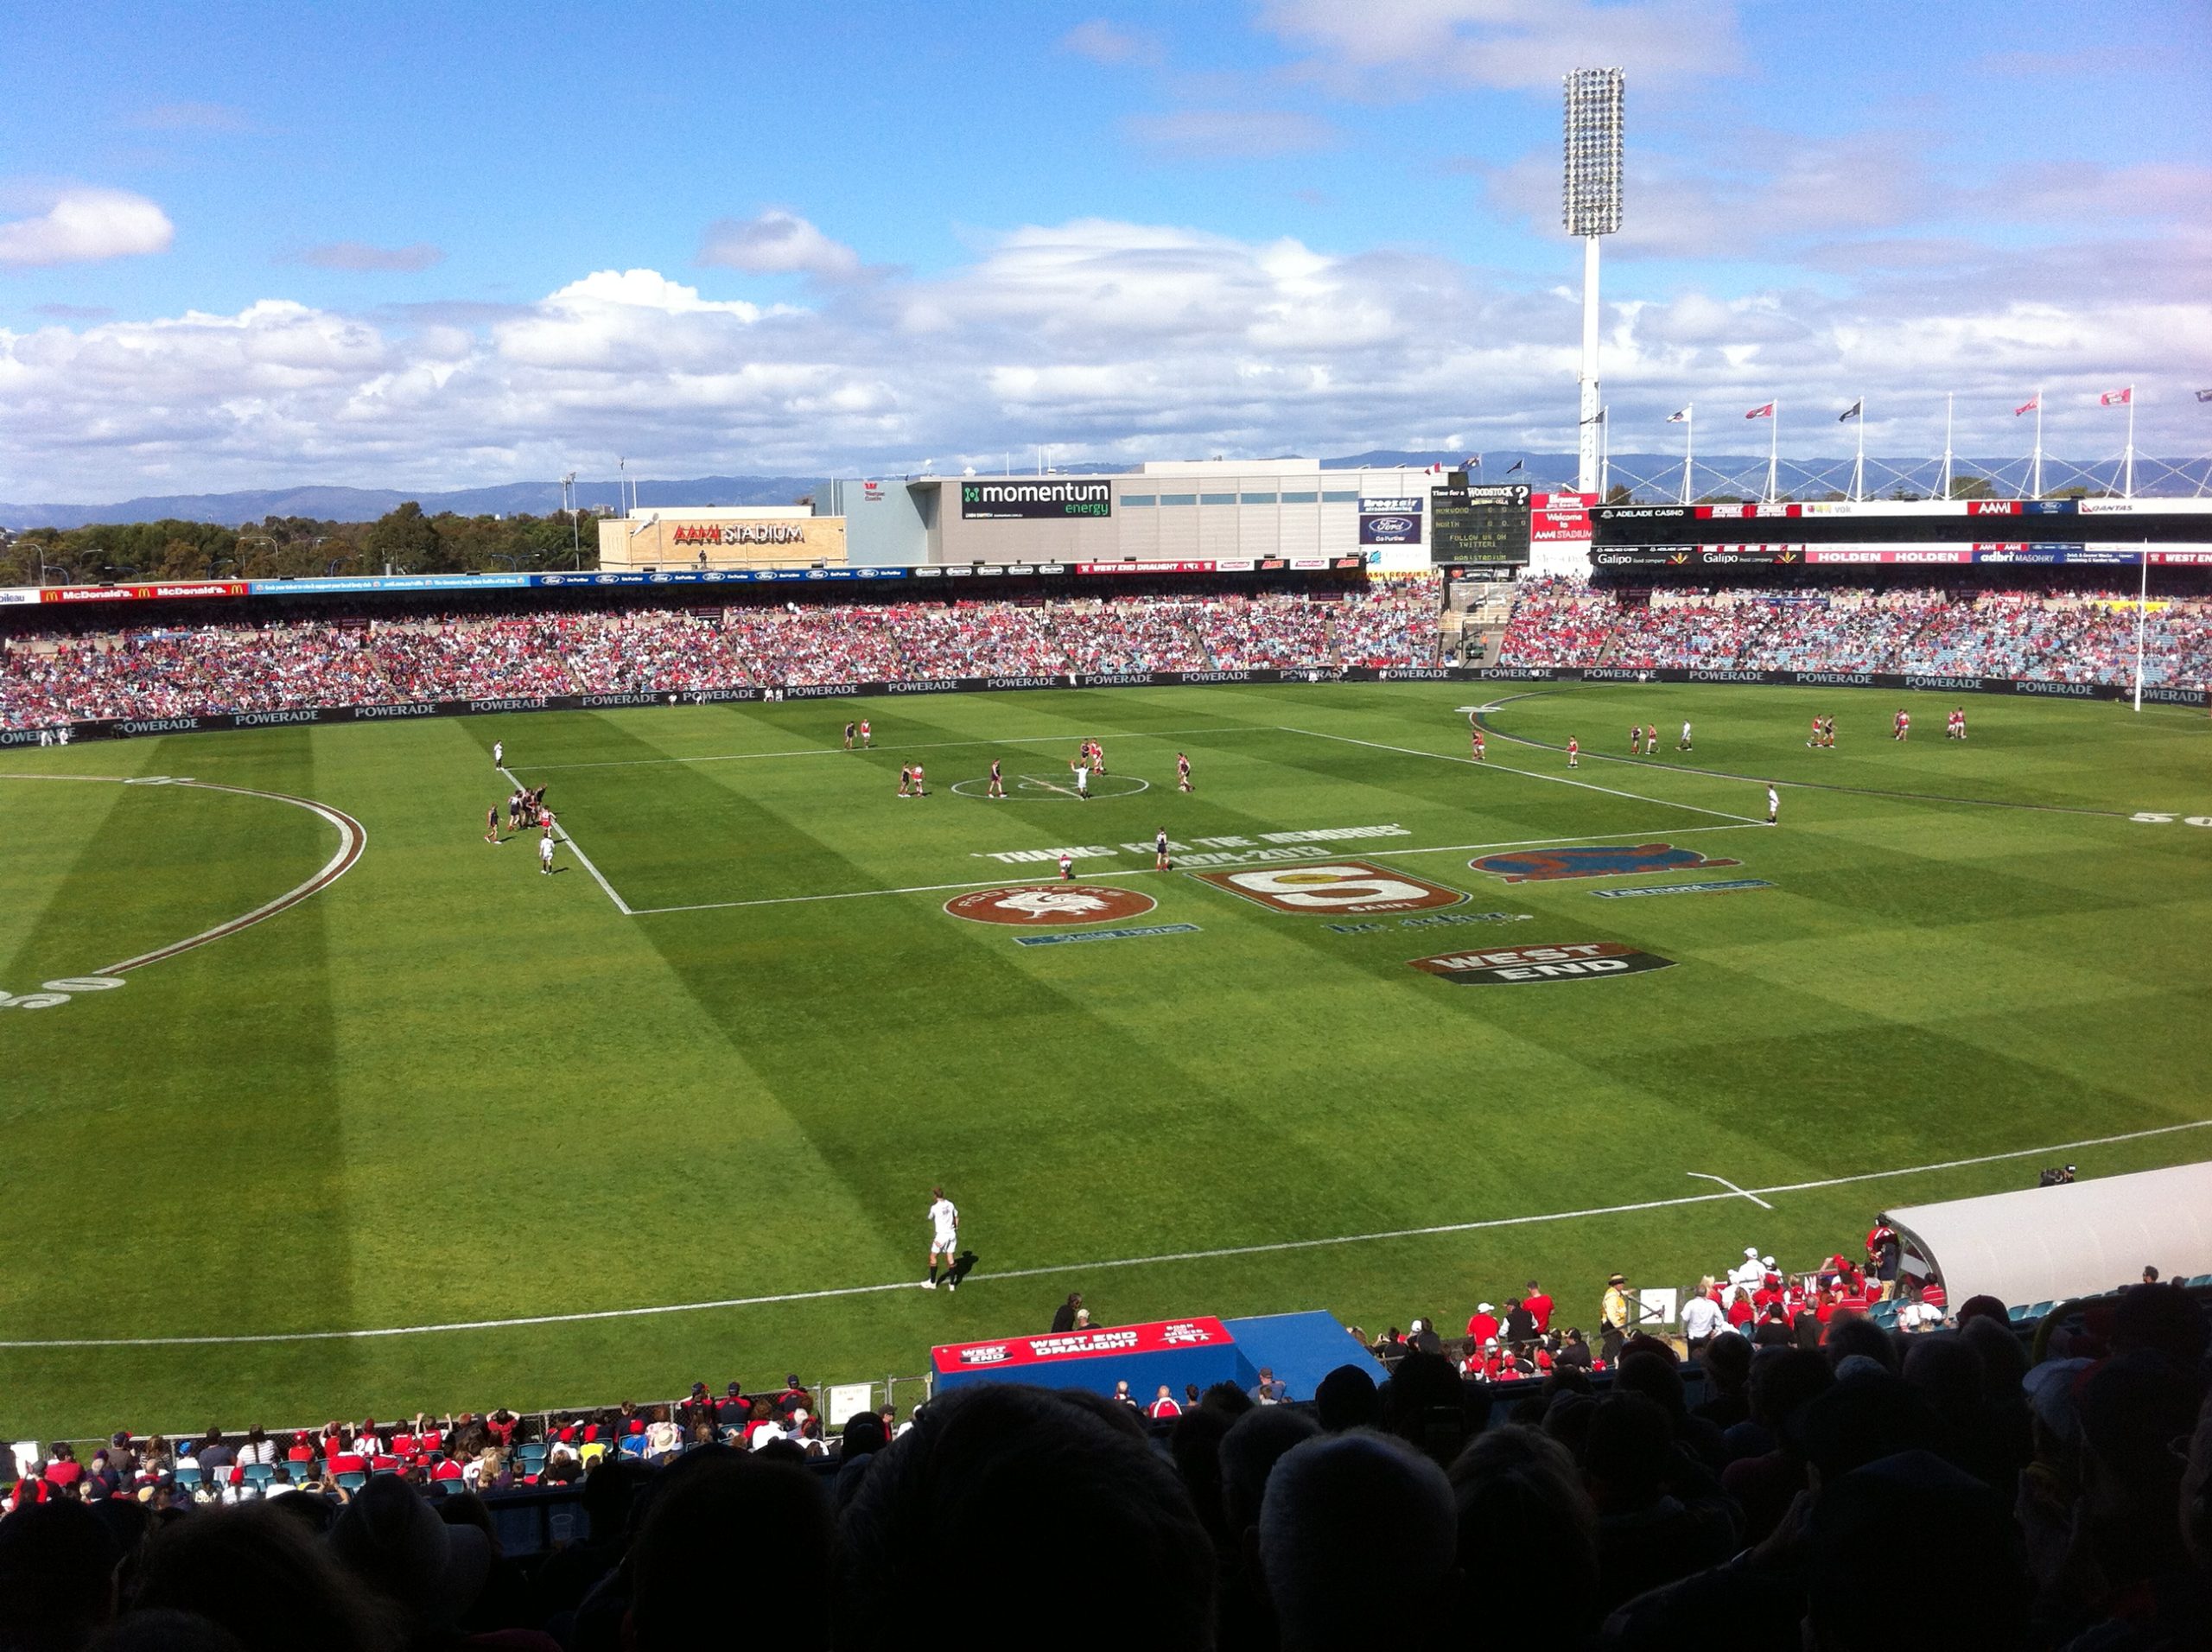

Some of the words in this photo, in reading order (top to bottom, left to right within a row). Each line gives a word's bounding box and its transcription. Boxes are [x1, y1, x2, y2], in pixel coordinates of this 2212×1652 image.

[982, 482, 1109, 502] momentum
[1467, 486, 1514, 498] WOODSTOCK
[1065, 503, 1109, 516] energy
[1978, 502, 2011, 514] AAMI
[1547, 512, 1582, 521] Welcome
[1376, 519, 1406, 531] Ford
[673, 524, 720, 541] AAMI
[724, 524, 804, 541] STADIUM
[1535, 531, 1555, 539] AAMI
[1557, 530, 1592, 538] STADIUM
[1598, 554, 1632, 565] Galipo
[1703, 553, 1738, 564] Galipo
[1818, 553, 1881, 562] HOLDEN
[1895, 553, 1959, 562] HOLDEN
[1980, 551, 2015, 562] adbri
[2015, 554, 2055, 562] MASONRY
[2165, 554, 2196, 562] WEST
[1085, 673, 1154, 685] POWERADE
[1182, 670, 1250, 682] POWERADE
[1383, 669, 1451, 679] OWERADE
[1584, 669, 1657, 679] POWERADE
[1689, 670, 1764, 681] POWERADE
[1796, 672, 1873, 684] POWERADE
[888, 680, 958, 692] POWERADE
[988, 677, 1056, 688] POWERADE
[1905, 676, 1983, 689] POWERADE
[2016, 681, 2094, 696] POWERADE
[683, 689, 756, 702] POWERADE
[787, 684, 858, 697] POWERADE
[2138, 688, 2205, 703] OWERADE
[471, 698, 549, 712] POWERADE
[582, 693, 658, 706] POWERADE
[355, 704, 436, 718] POWERADE
[235, 710, 319, 726] POWERADE
[1120, 842, 1192, 854] FOR
[1191, 836, 1259, 848] THE
[1169, 846, 1332, 866] 1974-2013
[1347, 902, 1421, 912] SANFL
[1428, 944, 1600, 969] WEST
[1493, 959, 1630, 981] END
[1030, 1336, 1088, 1349] WEST
[1092, 1331, 1137, 1342] END
[961, 1345, 1007, 1357] WEST
[1036, 1338, 1139, 1356] DRAUGHT
[969, 1354, 1005, 1363] END
[354, 1437, 376, 1456] 24
